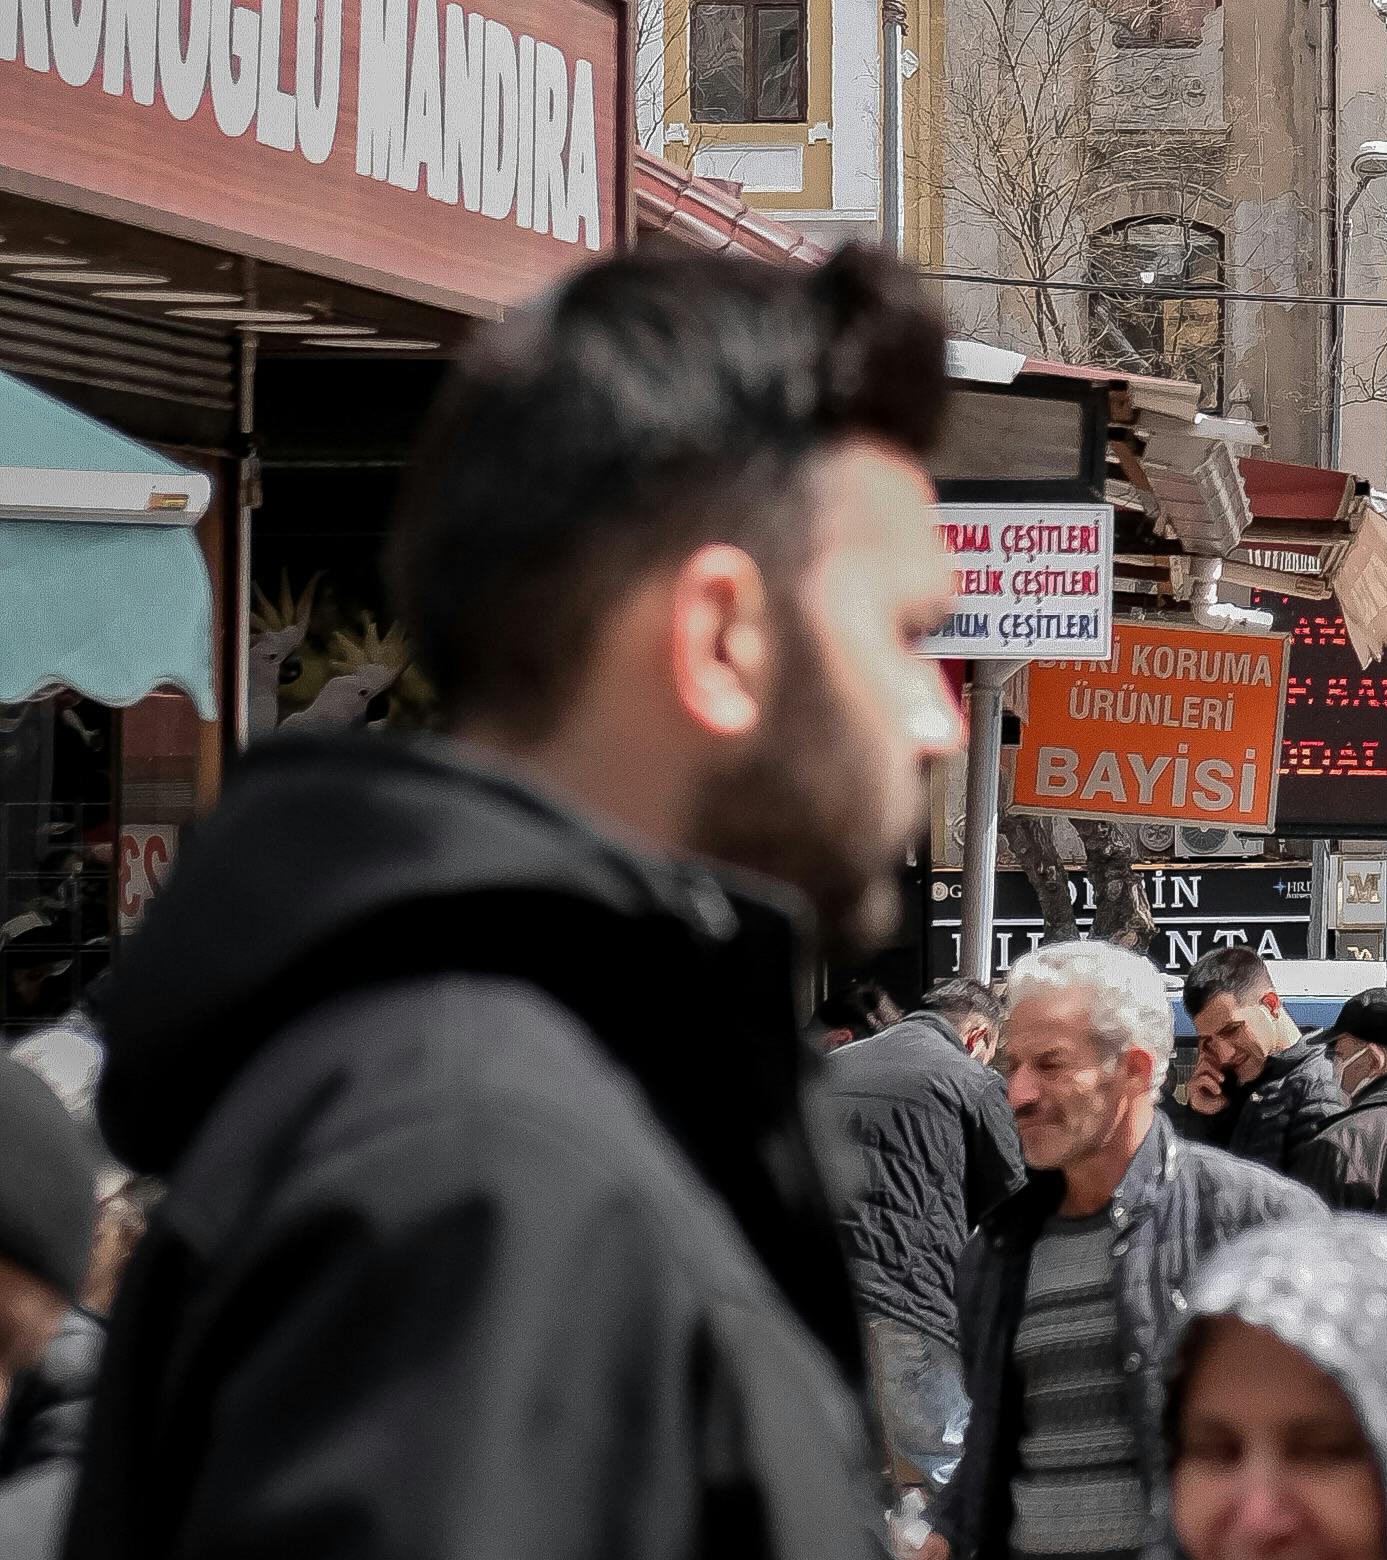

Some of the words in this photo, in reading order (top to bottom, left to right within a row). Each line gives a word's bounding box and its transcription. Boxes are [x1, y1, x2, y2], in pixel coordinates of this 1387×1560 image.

[1001, 518, 1100, 562] ÇEŞİTLERİ
[1012, 564, 1100, 603] ÇEŞİTLERİ
[999, 609, 1100, 646] ÇEŞİTLERİ
[1131, 644, 1273, 688] KORUMA
[1069, 681, 1234, 732] ÜRÜNLERİ
[1034, 742, 1257, 813] BAYİSİ
